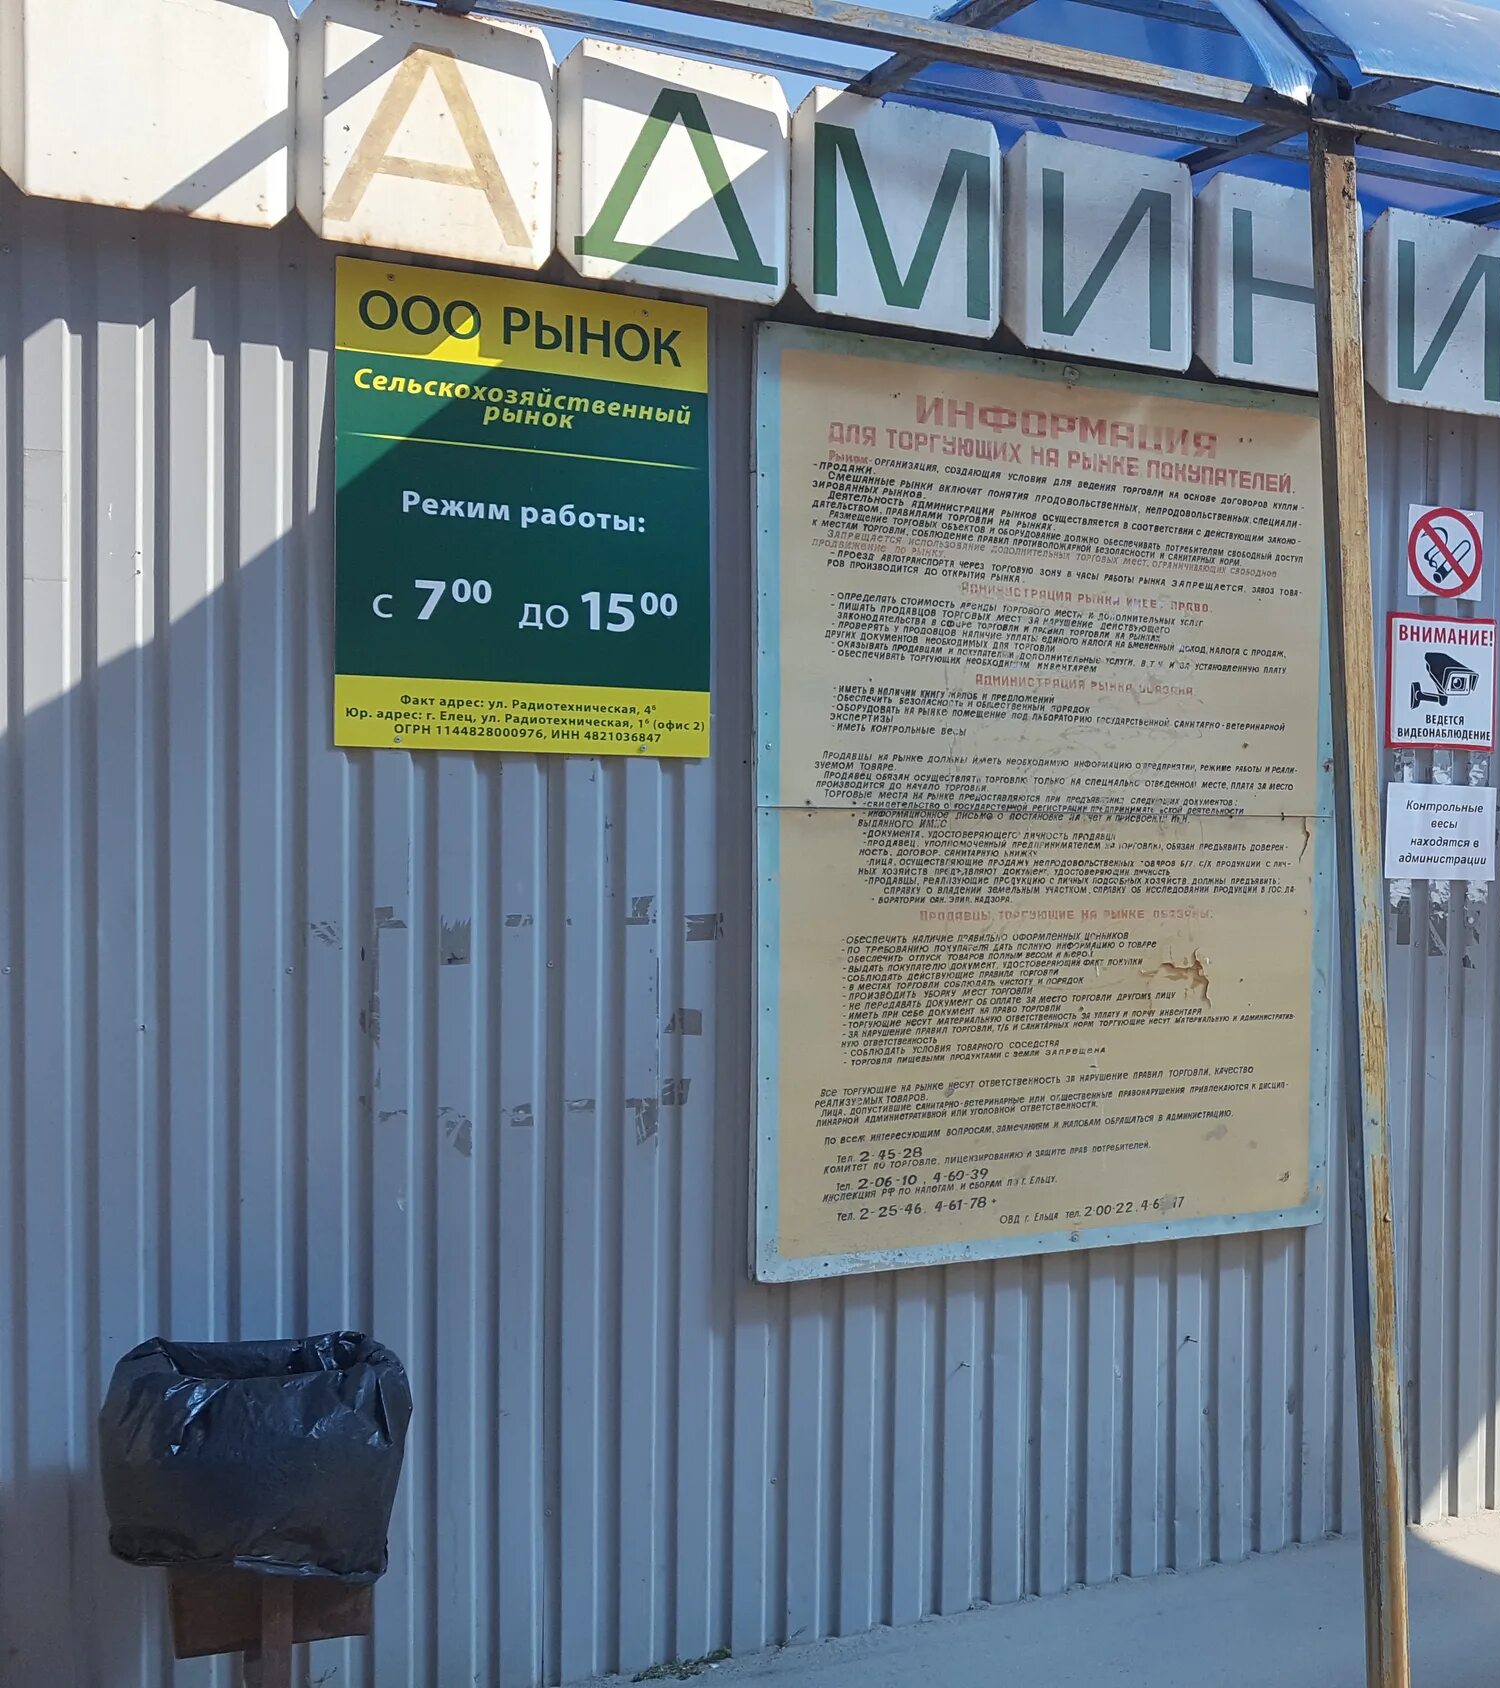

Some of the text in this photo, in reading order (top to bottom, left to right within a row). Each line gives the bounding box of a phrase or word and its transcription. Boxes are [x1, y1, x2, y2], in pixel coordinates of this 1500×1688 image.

[358, 289, 682, 368] ООО РЫНОК
[353, 367, 692, 425] Сельскохозяйственный
[482, 403, 574, 429] рынок
[916, 394, 1217, 459] ИНФОРМАЦИЯ
[827, 420, 876, 448] ДЛЯ
[885, 427, 1022, 464] ТОРГУЮЩИХ
[1030, 445, 1059, 468] НА
[1067, 449, 1139, 477] РЫНКЕ
[402, 490, 646, 533] Режим работы:
[1399, 623, 1494, 647] ВНИМАНИЕ!
[400, 694, 435, 706] Факт
[439, 697, 484, 710] адрес:
[488, 699, 508, 710] ул.
[512, 699, 640, 716] Радиотехническая,
[345, 707, 373, 720] Юр.
[376, 709, 422, 722] адрес:
[426, 711, 435, 720] г.
[440, 711, 477, 723] Елец,
[481, 714, 500, 724] ул.
[504, 713, 634, 729] Радиотехническая,
[653, 719, 690, 732] (офис
[693, 720, 705, 732] 2)
[1425, 714, 1465, 726] ВЕДЕТСЯ
[394, 723, 662, 743] ОГРН 1144828000976, ИНН 4821036847
[1397, 727, 1491, 741] ВИДЕОНАБЛЮДЕНИЕ
[1406, 799, 1484, 814] Контрольные
[1430, 820, 1458, 829] весы
[1410, 837, 1480, 849] находятся в
[1398, 852, 1487, 866] администрации
